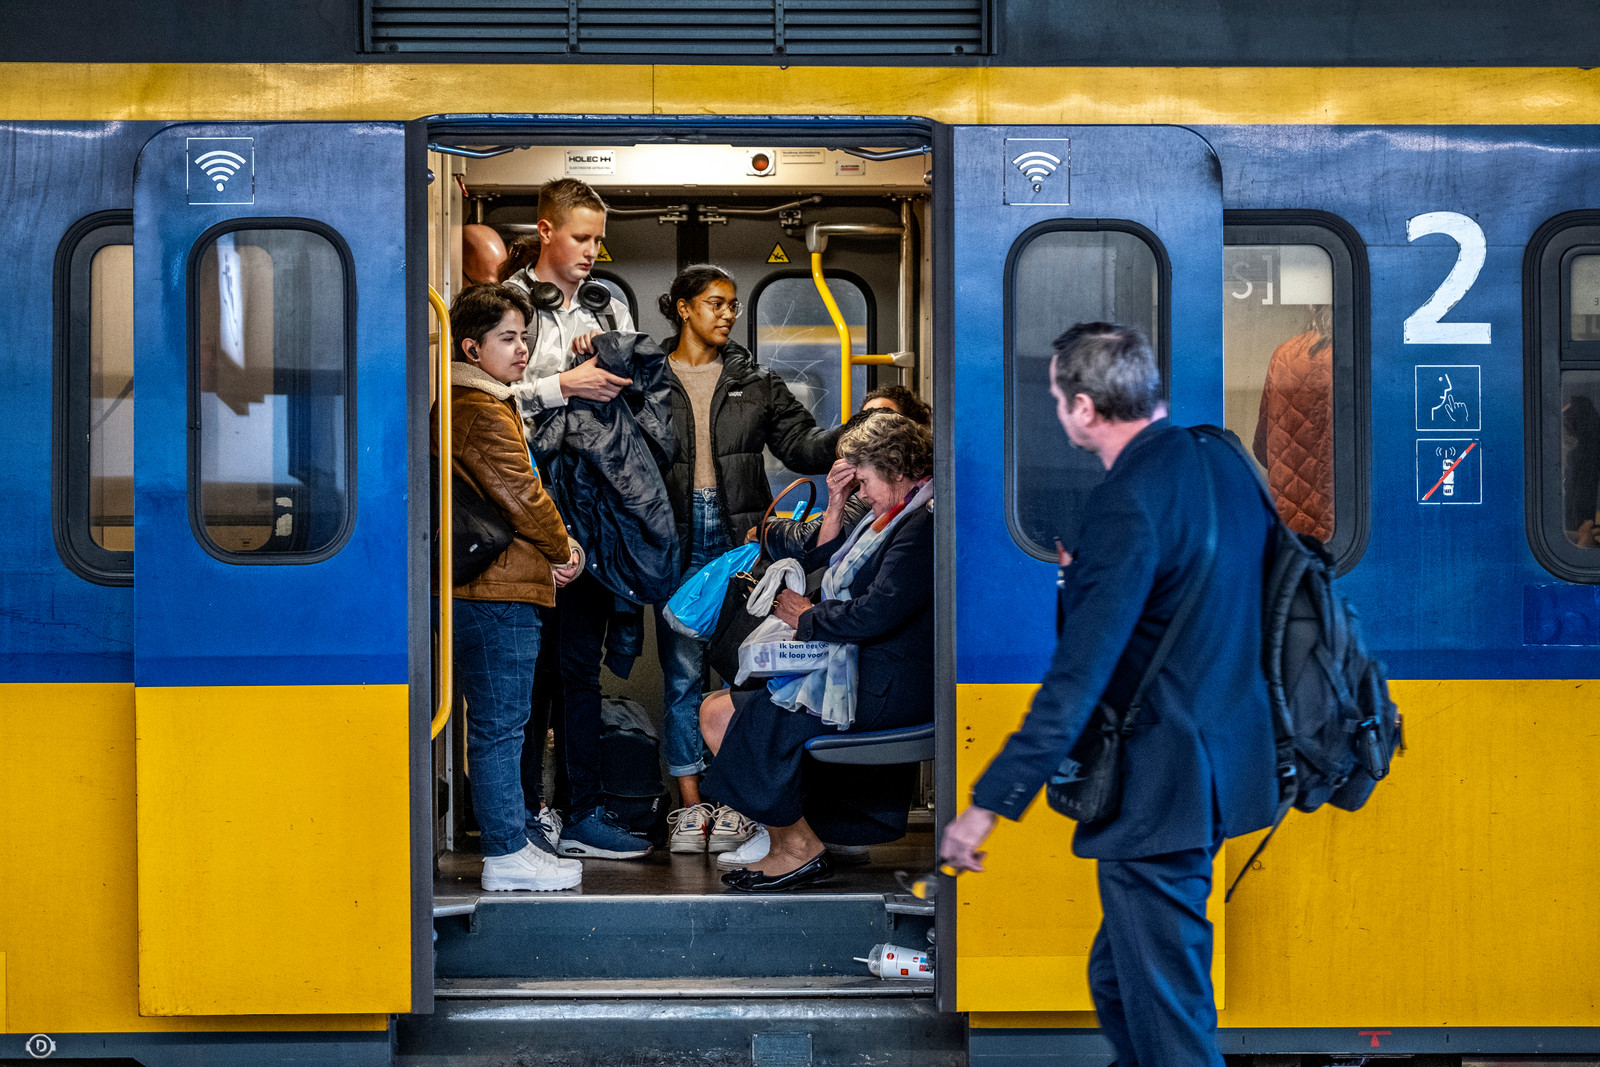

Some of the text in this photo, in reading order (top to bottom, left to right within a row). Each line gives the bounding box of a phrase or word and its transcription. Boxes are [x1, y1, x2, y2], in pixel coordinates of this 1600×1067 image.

[1403, 211, 1491, 344] 2
[779, 651, 787, 659] Ik
[789, 651, 806, 660] loop
